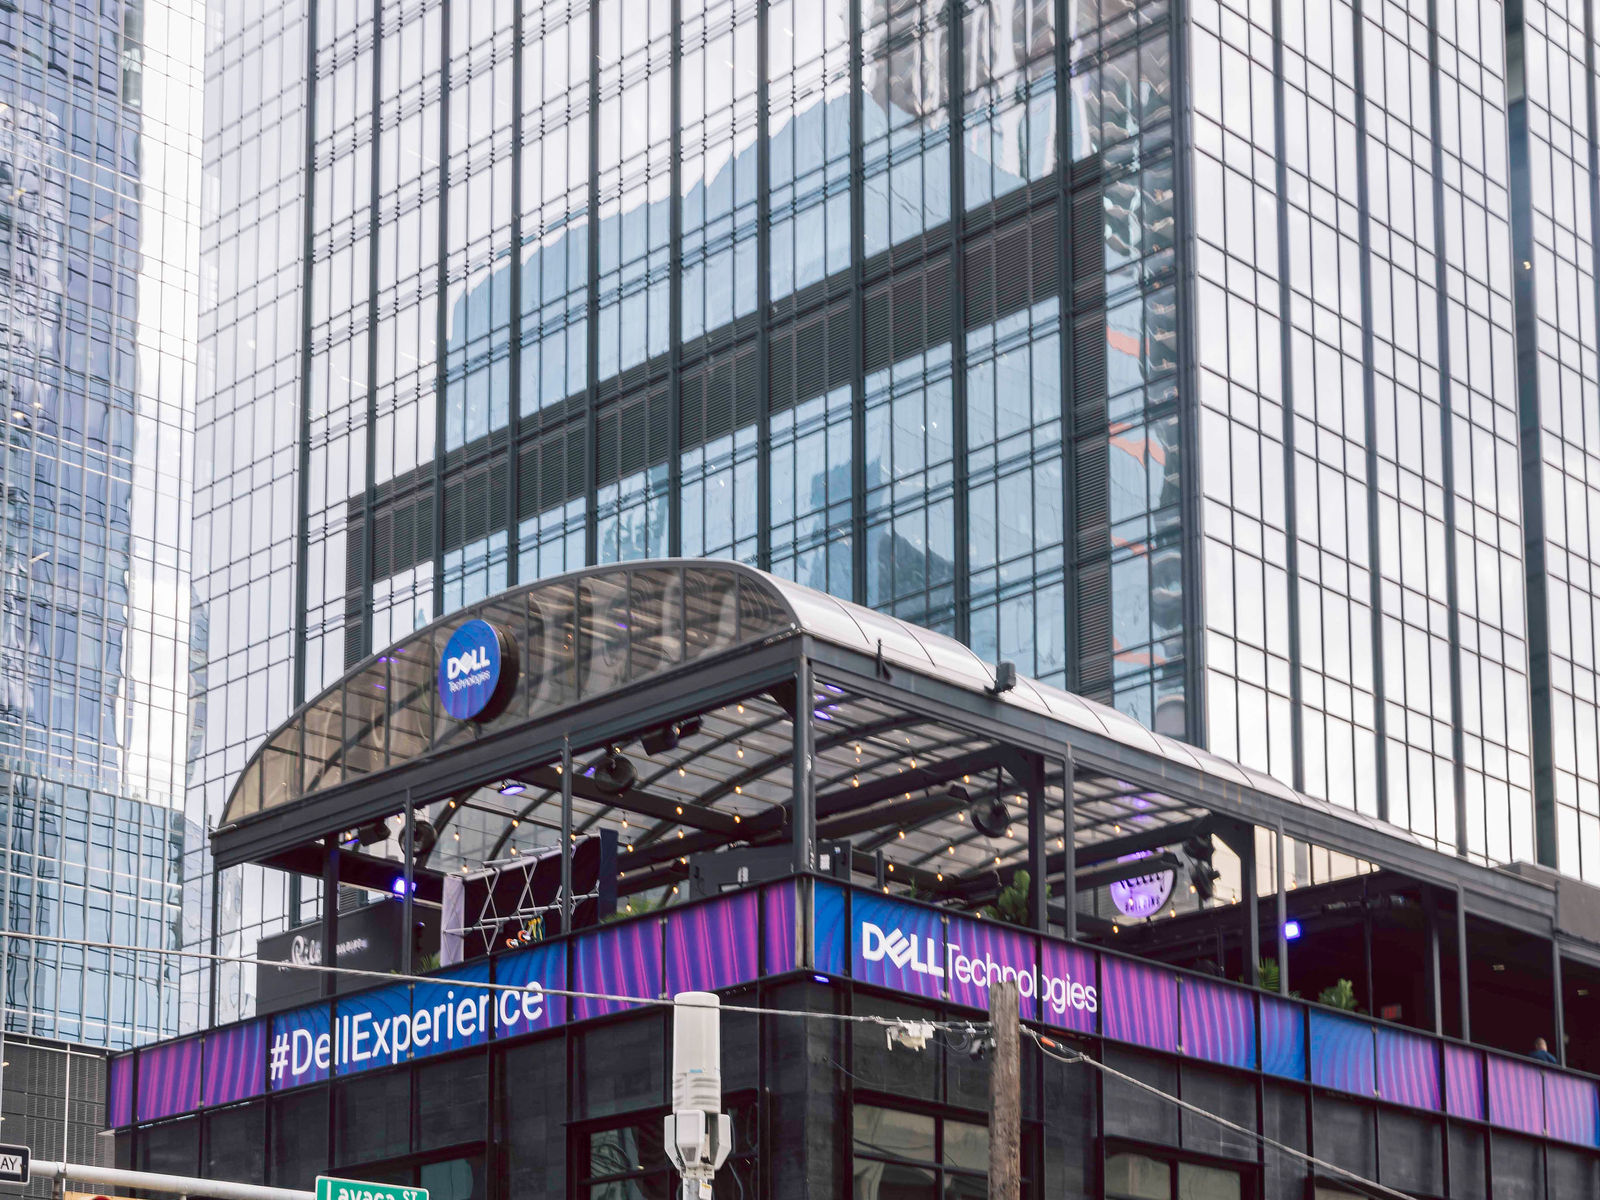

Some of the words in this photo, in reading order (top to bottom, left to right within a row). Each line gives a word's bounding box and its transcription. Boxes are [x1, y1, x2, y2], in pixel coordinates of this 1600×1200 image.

[447, 646, 491, 680] DELL
[862, 921, 945, 977] DELL
[942, 943, 1098, 1014] Technologies
[270, 981, 544, 1081] #DellExperience
